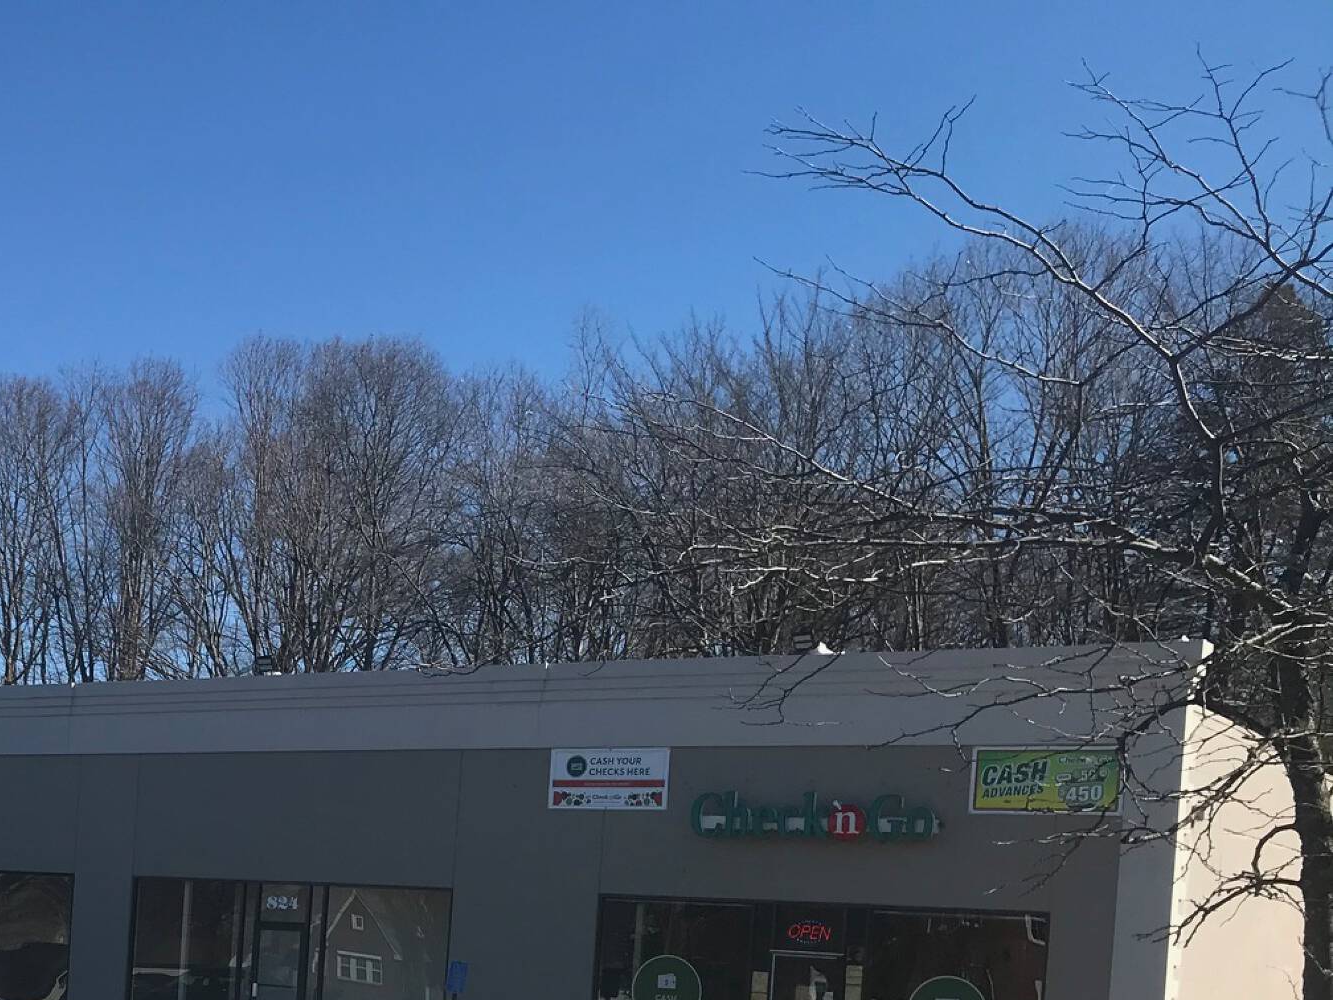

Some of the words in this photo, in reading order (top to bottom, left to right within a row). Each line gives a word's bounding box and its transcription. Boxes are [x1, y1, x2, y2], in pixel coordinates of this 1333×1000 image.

[590, 757, 614, 765] CASH
[616, 757, 642, 766] YOUR
[589, 767, 625, 776] CHECKS
[626, 767, 650, 776] HERE
[982, 760, 1048, 787] CASH
[983, 783, 1044, 799] ADVANCES
[691, 791, 827, 838] Check
[869, 794, 936, 842] Go
[266, 896, 298, 910] 824
[786, 923, 832, 941] OPEN
